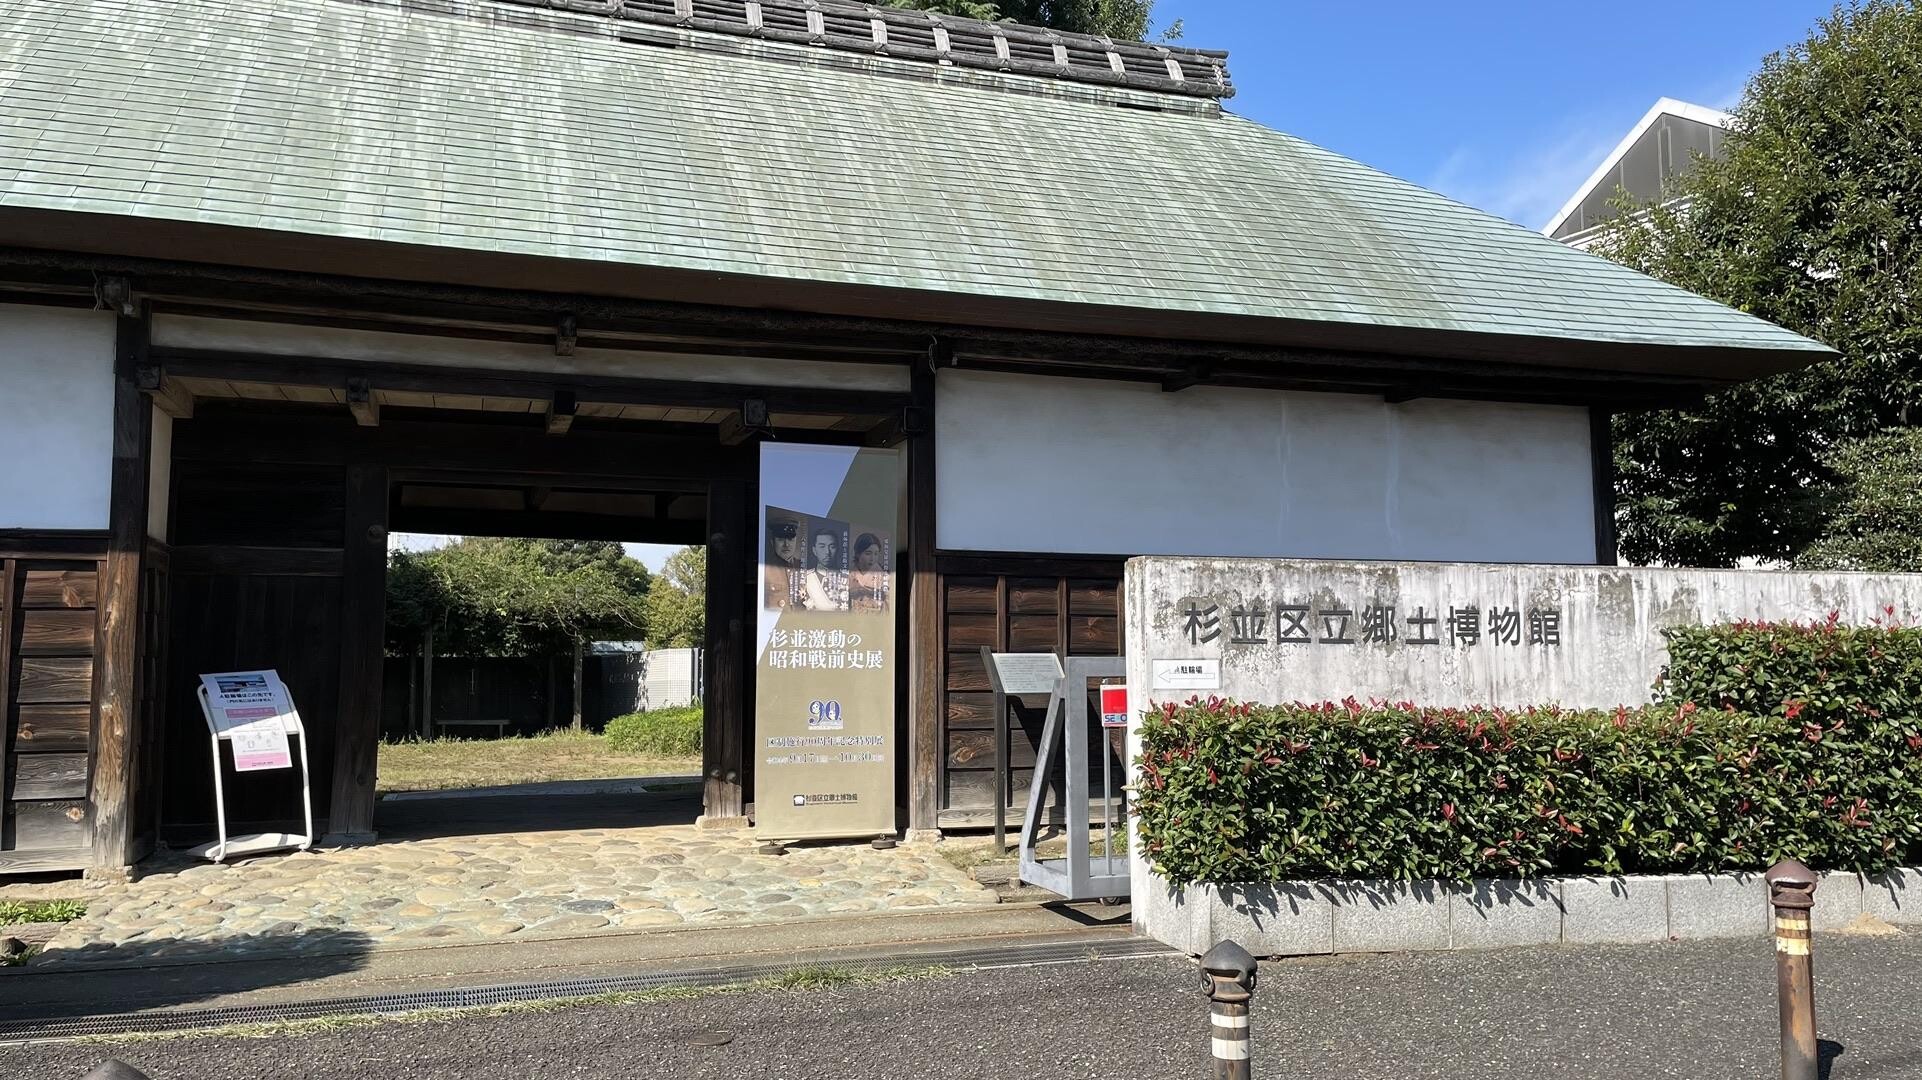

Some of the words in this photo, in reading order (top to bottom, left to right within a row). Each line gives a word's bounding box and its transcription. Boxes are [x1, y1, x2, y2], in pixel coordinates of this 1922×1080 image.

[1183, 602, 1560, 647] 杉並区立郷土博物館
[769, 629, 862, 648] 杉並激動の
[769, 650, 883, 669] 昭和戦前史展
